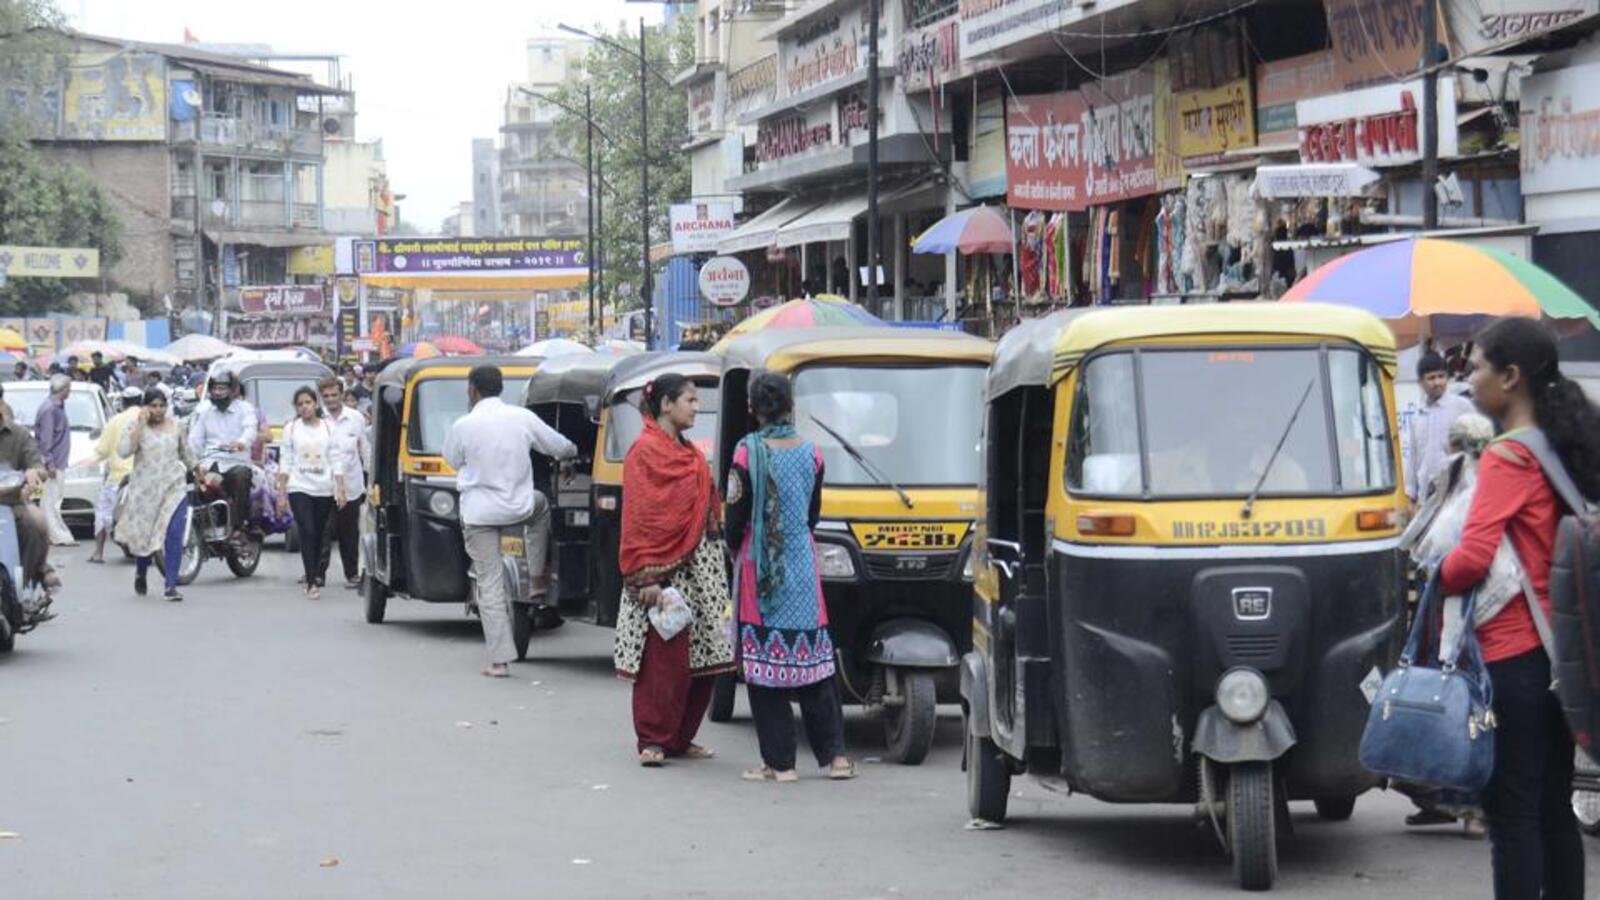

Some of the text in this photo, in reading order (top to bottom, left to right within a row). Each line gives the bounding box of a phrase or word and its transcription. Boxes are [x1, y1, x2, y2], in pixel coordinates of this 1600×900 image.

[1009, 125, 1040, 168] कला
[675, 220, 732, 232] ARCHANA
[24, 253, 61, 269] WELCOME
[1239, 597, 1265, 613] RE
